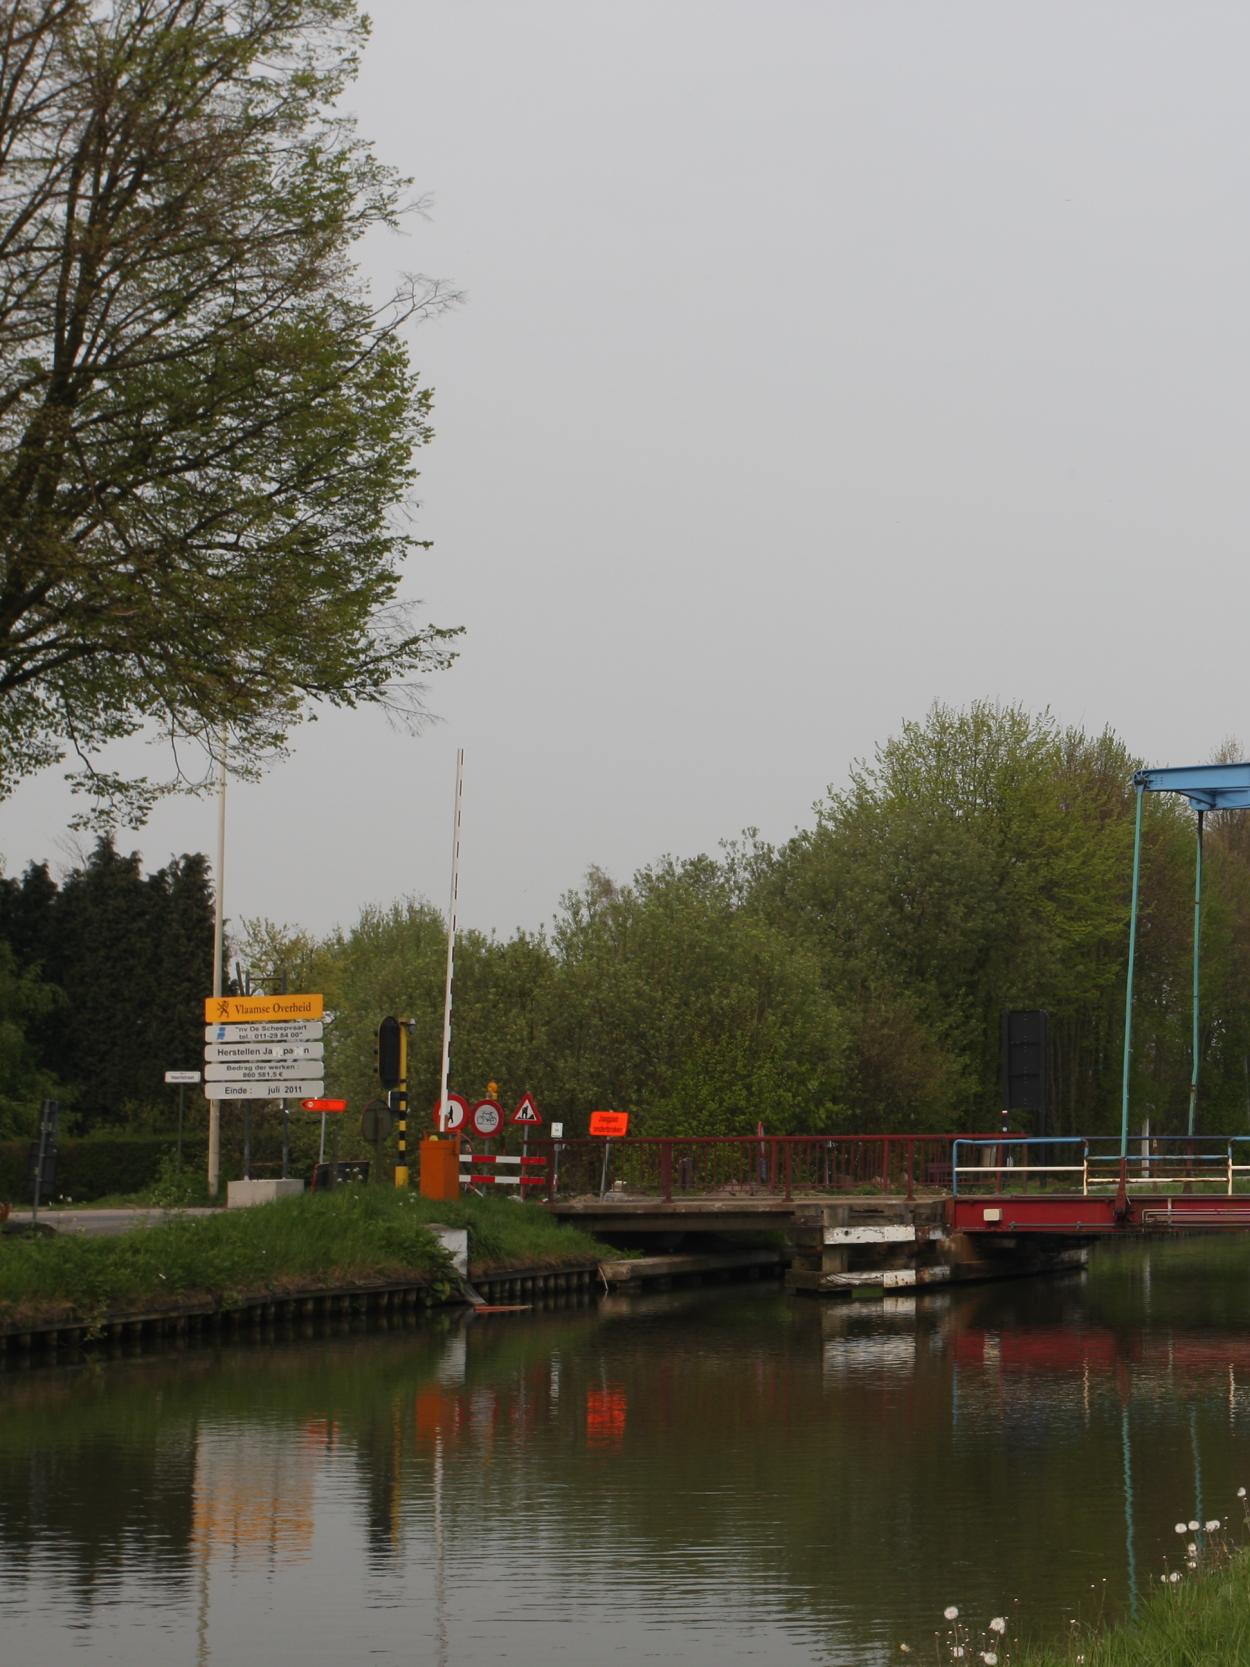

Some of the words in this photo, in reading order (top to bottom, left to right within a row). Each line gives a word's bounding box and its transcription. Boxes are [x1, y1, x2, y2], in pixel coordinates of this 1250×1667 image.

[235, 1004, 271, 1014] Vlaamse
[272, 1002, 311, 1013] Overheid
[217, 1048, 261, 1056] Herstellen
[224, 1086, 248, 1094] Einde
[268, 1086, 280, 1095] juli
